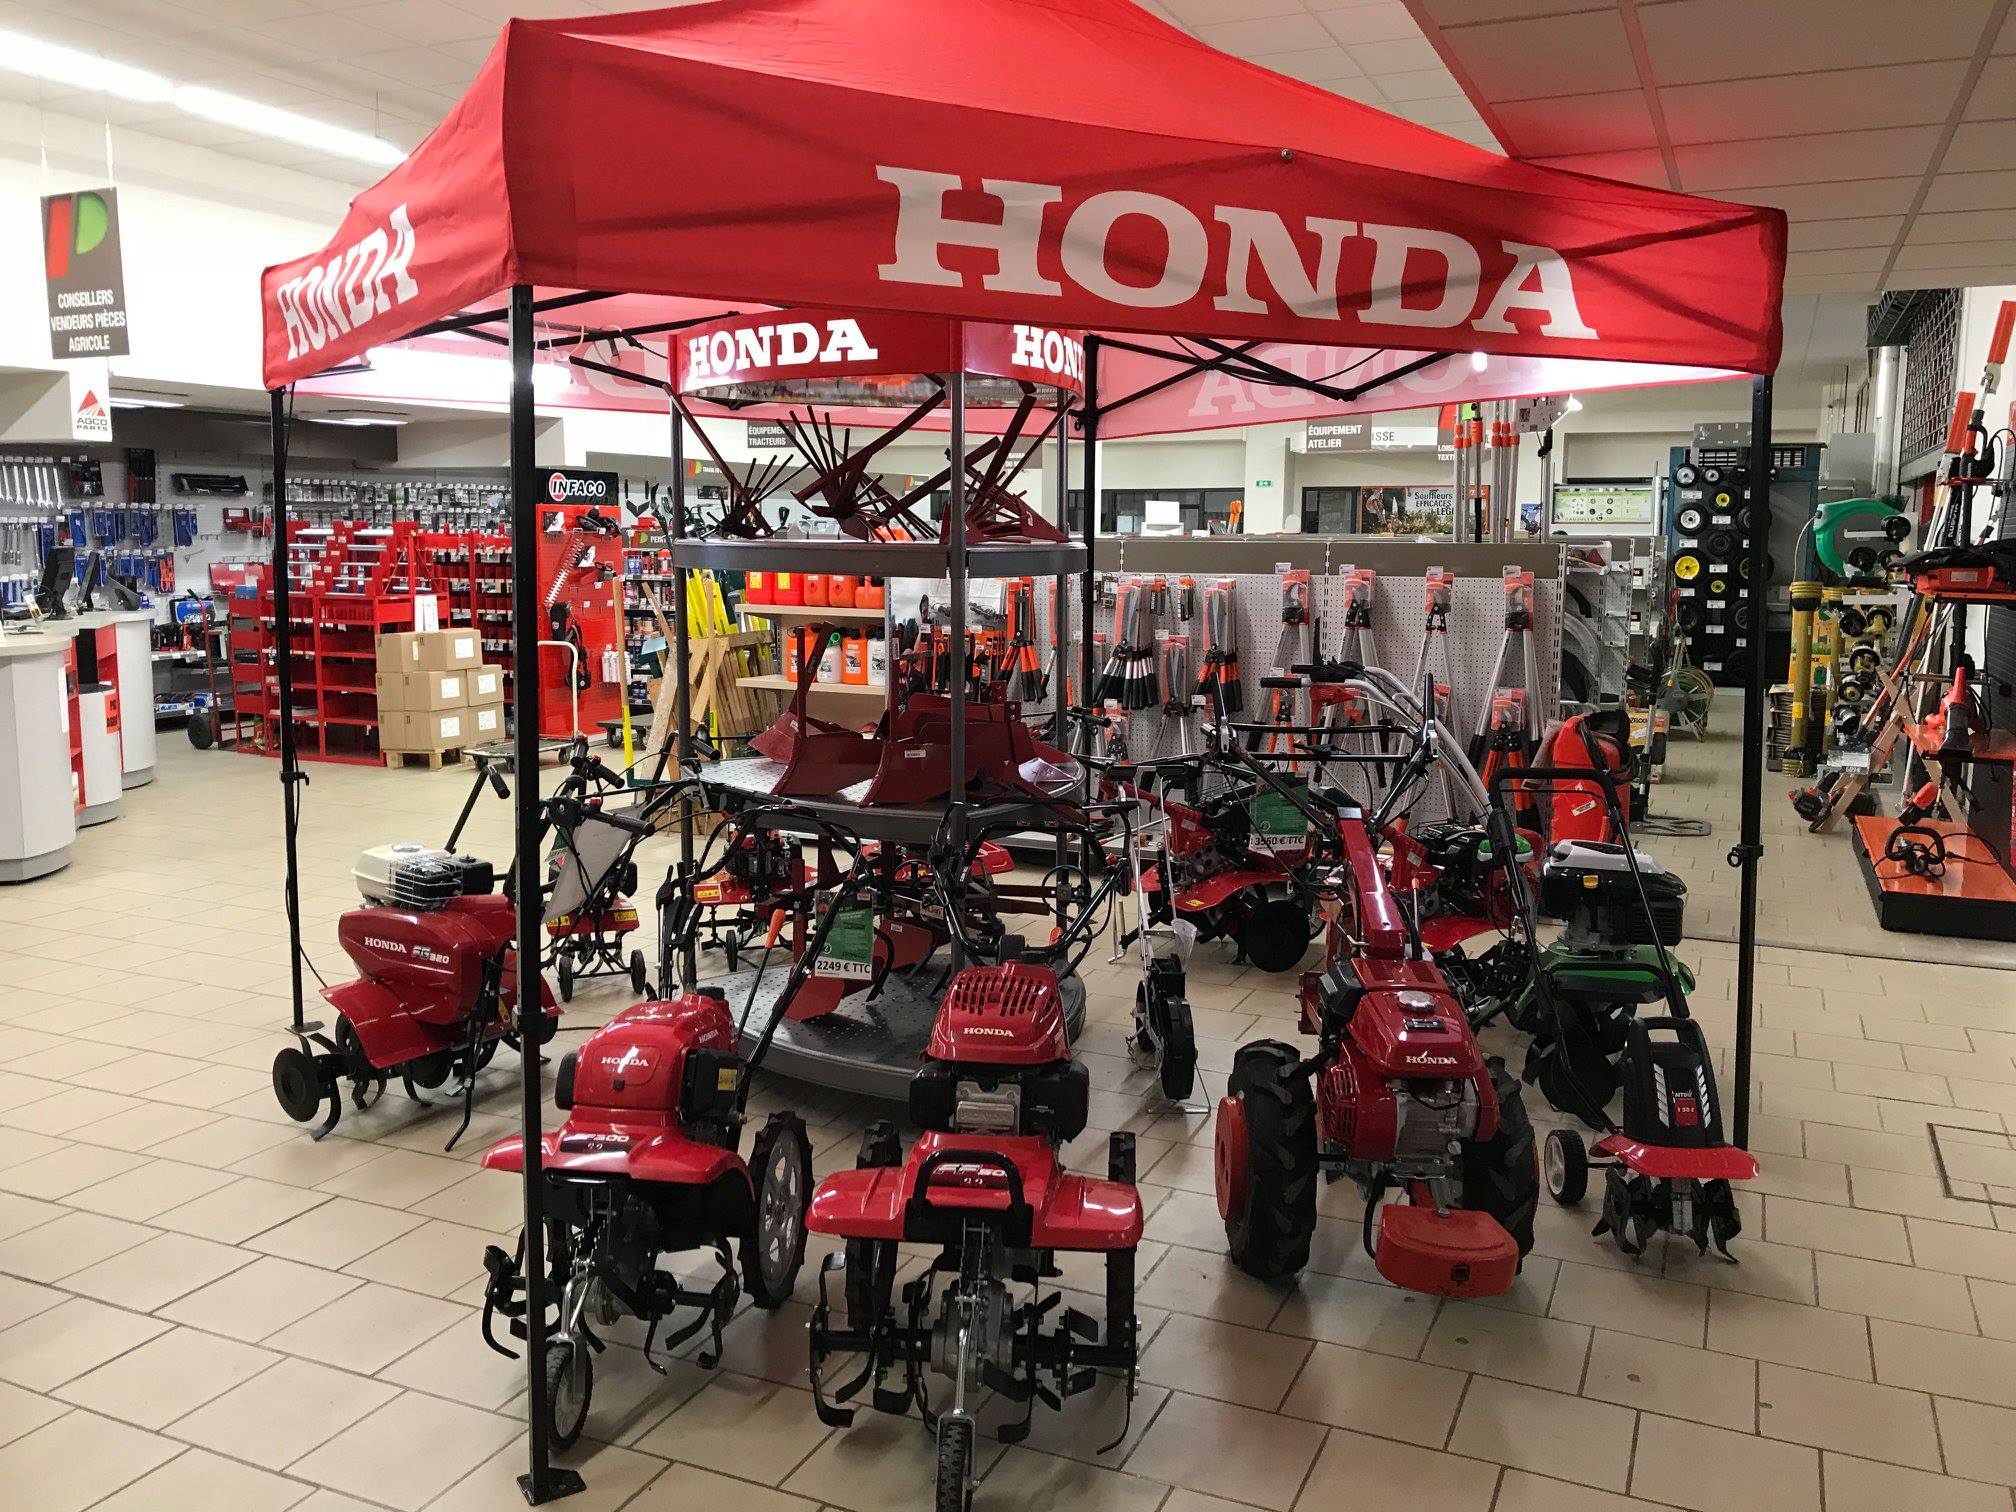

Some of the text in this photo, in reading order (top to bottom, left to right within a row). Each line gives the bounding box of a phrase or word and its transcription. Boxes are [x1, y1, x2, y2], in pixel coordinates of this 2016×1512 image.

[876, 164, 1598, 341] HONDA
[277, 203, 419, 361] HONDA
[57, 289, 114, 309] CONSEILLERS
[51, 309, 125, 332] VENDEURS PIÈCES
[69, 334, 110, 352] AGRICOLE
[688, 318, 878, 379] HONDA
[1012, 324, 1084, 383] HON
[76, 424, 108, 432] PARTS
[77, 417, 108, 426] AGCO
[748, 425, 789, 435] ÉQUIPEMEN
[1308, 424, 1363, 436] ÉQUIPEMENT
[748, 437, 786, 446] TRACTEURS
[1308, 438, 1342, 449] ATELIER
[550, 479, 606, 497] INFACO
[1414, 491, 1453, 500] Souffleurs
[1416, 500, 1452, 508] EFFICACES
[1287, 835, 1305, 845] TTC
[364, 936, 407, 954] HONDA
[817, 960, 841, 972] 2249
[843, 962, 850, 972] €
[852, 963, 870, 974] TTC
[963, 1027, 1014, 1038] HONDA
[1405, 1055, 1458, 1065] HONDA
[933, 1163, 1008, 1177] FF50
